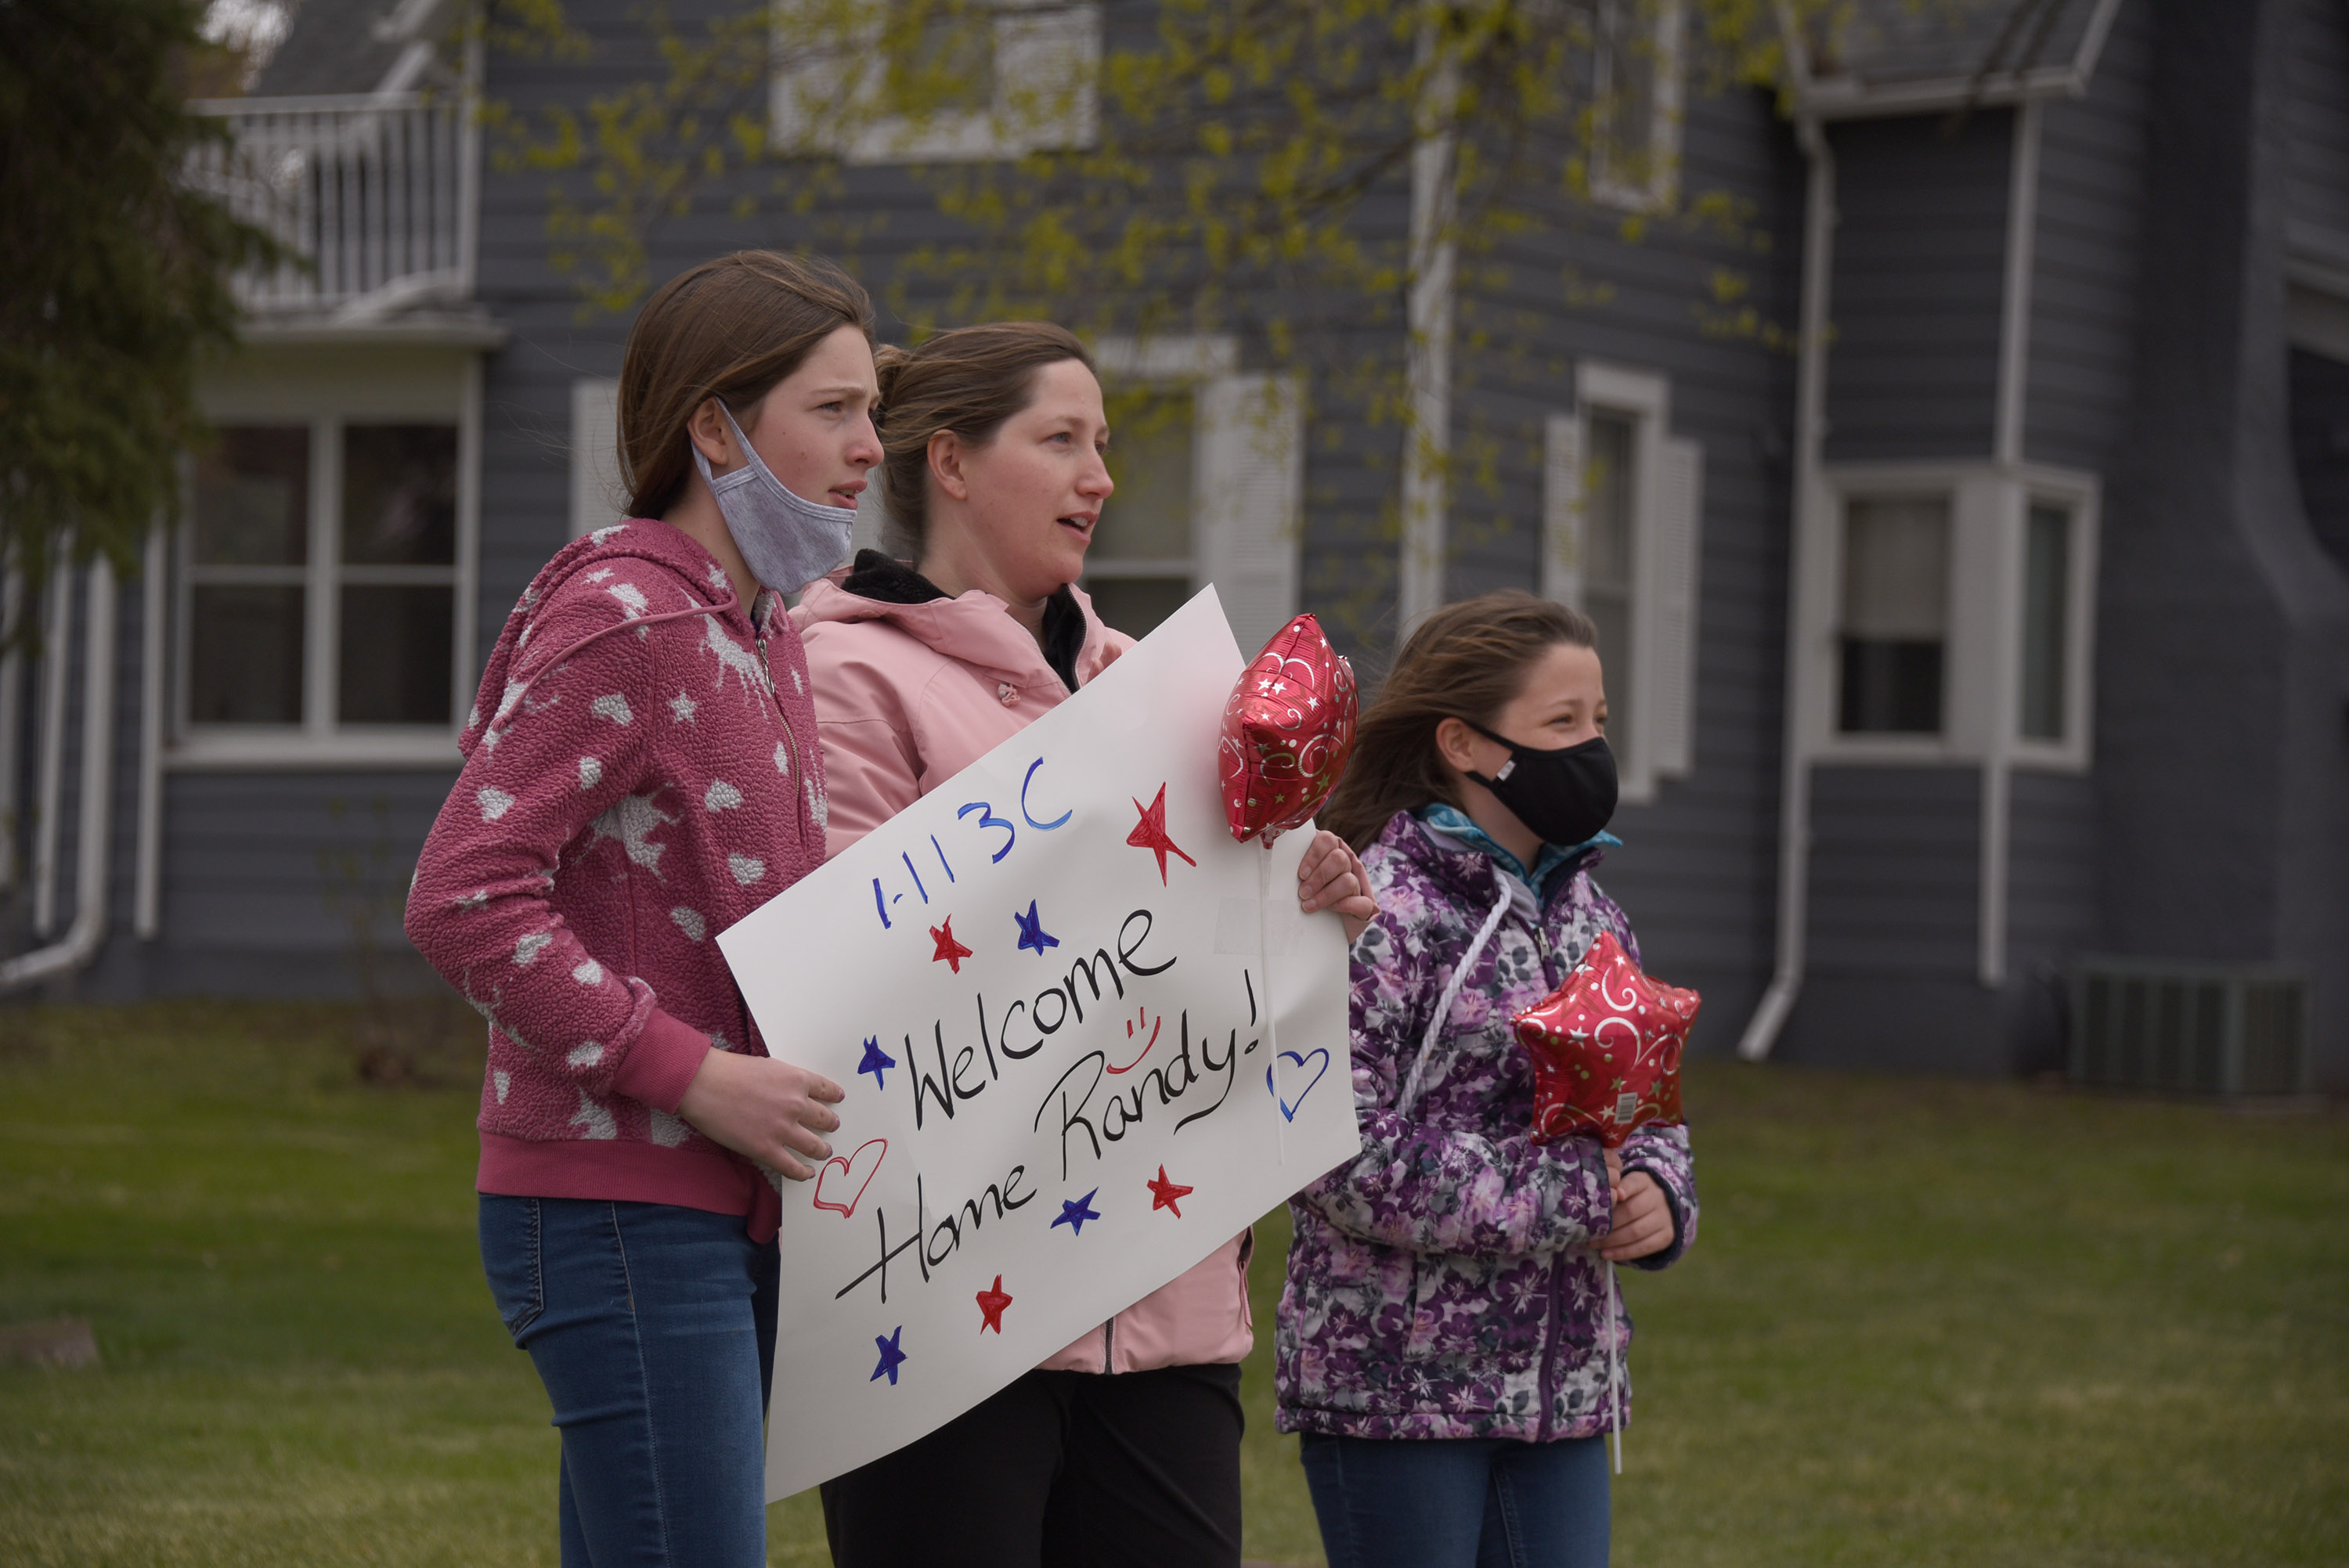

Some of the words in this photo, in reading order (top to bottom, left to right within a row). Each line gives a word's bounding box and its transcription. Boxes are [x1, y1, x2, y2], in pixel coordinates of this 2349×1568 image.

[835, 1164, 1037, 1304] Home
[1034, 968, 1259, 1181] Randy!
[904, 909, 1177, 1131] Welcome
